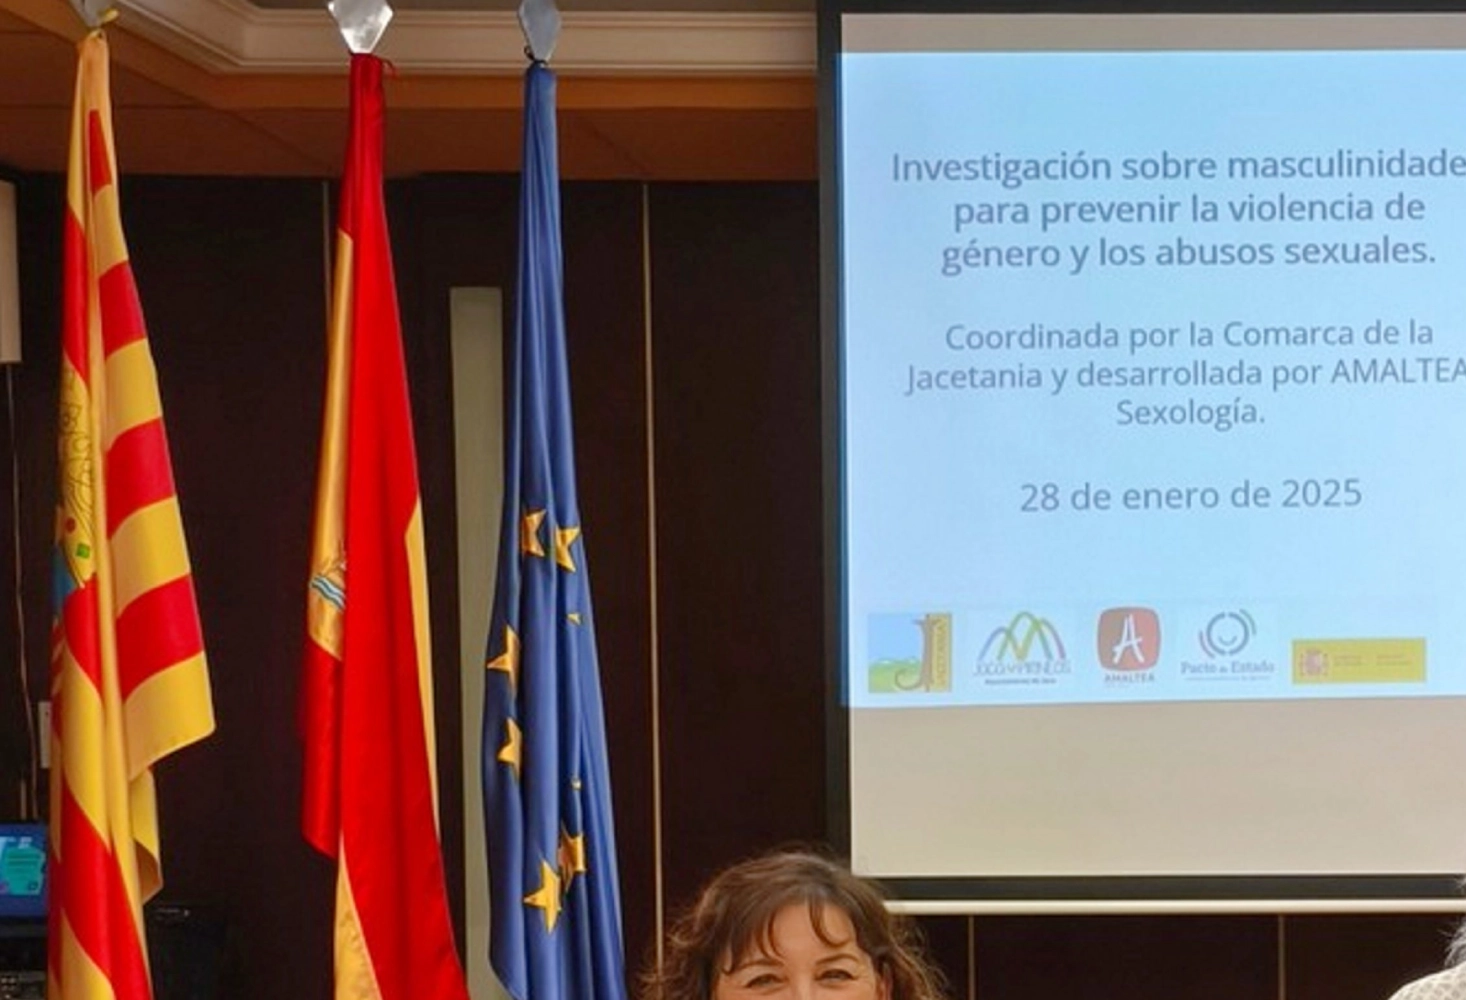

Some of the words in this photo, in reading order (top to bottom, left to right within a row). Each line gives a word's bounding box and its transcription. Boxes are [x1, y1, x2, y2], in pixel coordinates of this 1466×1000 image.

[893, 151, 1111, 189] Investigación
[1122, 150, 1217, 180] sobre
[955, 202, 1029, 233] para
[1042, 194, 1181, 232] prevenir
[1192, 193, 1218, 222] la
[1228, 192, 1373, 222] violencia
[1385, 192, 1425, 220] de
[941, 238, 1060, 277] género
[1070, 245, 1090, 275] y
[1100, 237, 1145, 265] los
[1156, 236, 1274, 265] abusos
[1285, 235, 1435, 264] sexuales.
[946, 322, 1118, 350] Coordinada
[1130, 328, 1180, 355] por
[1190, 321, 1213, 347] la
[1224, 321, 1353, 347] Comarca
[1364, 319, 1399, 345] de
[1410, 318, 1433, 344] la
[904, 363, 1042, 396] Jacetania
[1051, 368, 1068, 395] y
[1077, 359, 1261, 387] desarrollada
[1273, 365, 1322, 392] por
[1117, 397, 1264, 432] Sexología.
[1021, 483, 1059, 512] 28
[1071, 482, 1111, 510] de
[1123, 488, 1219, 509] enero
[1231, 480, 1271, 508] de
[1282, 478, 1362, 507] 2025
